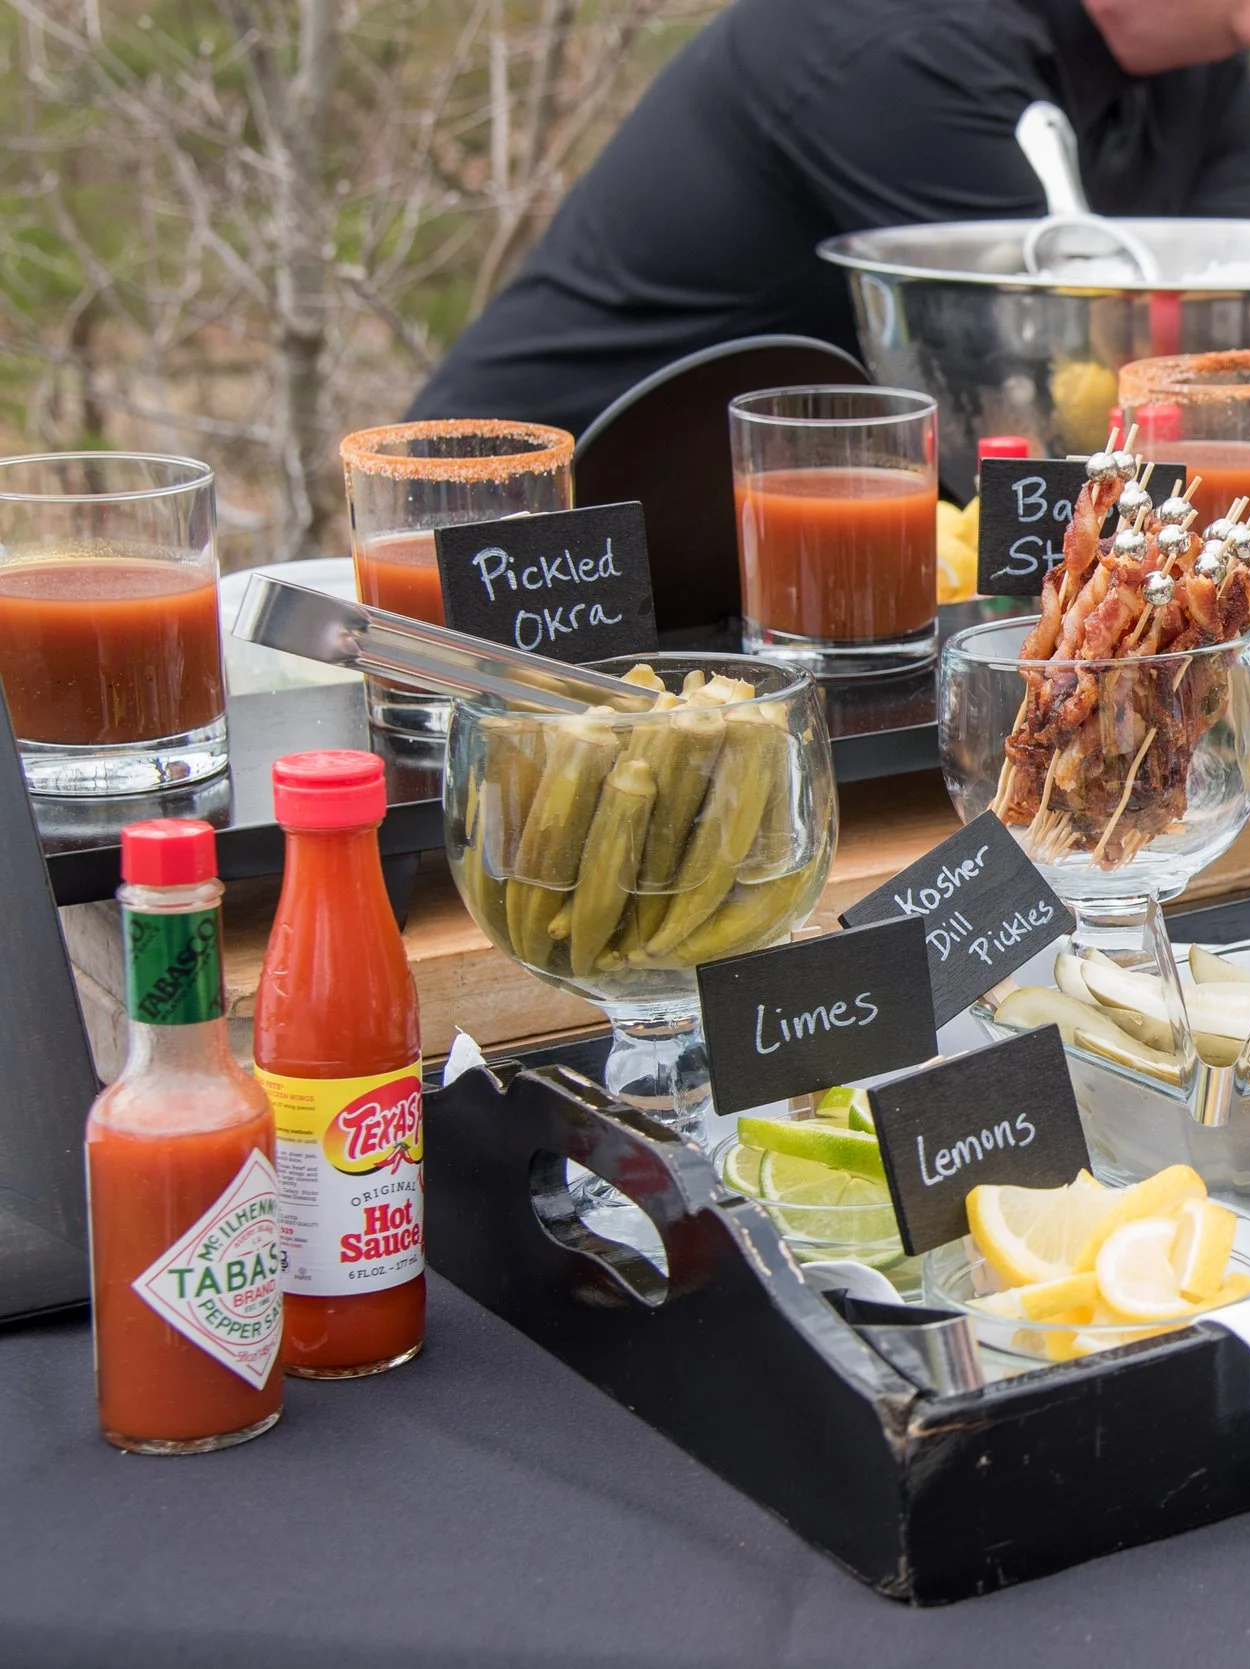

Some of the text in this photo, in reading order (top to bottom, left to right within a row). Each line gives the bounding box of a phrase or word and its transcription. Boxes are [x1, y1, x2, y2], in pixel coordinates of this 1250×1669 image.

[472, 537, 622, 602] Pickled
[894, 845, 989, 917] Kosher
[924, 911, 973, 962] Dill
[968, 899, 1055, 966] Pickles
[138, 917, 215, 1019] TABASCO
[755, 992, 878, 1055] Limes
[339, 1091, 418, 1162] TEXAS
[916, 1112, 1036, 1187] Lemons
[351, 1181, 416, 1207] ORIGINAL
[364, 1198, 413, 1237] Hot
[168, 1242, 278, 1298] TABAS
[340, 1223, 420, 1263] Sauce
[234, 1279, 276, 1308] BRAND
[349, 1271, 355, 1279] 6
[198, 1299, 262, 1339] PEPPER
